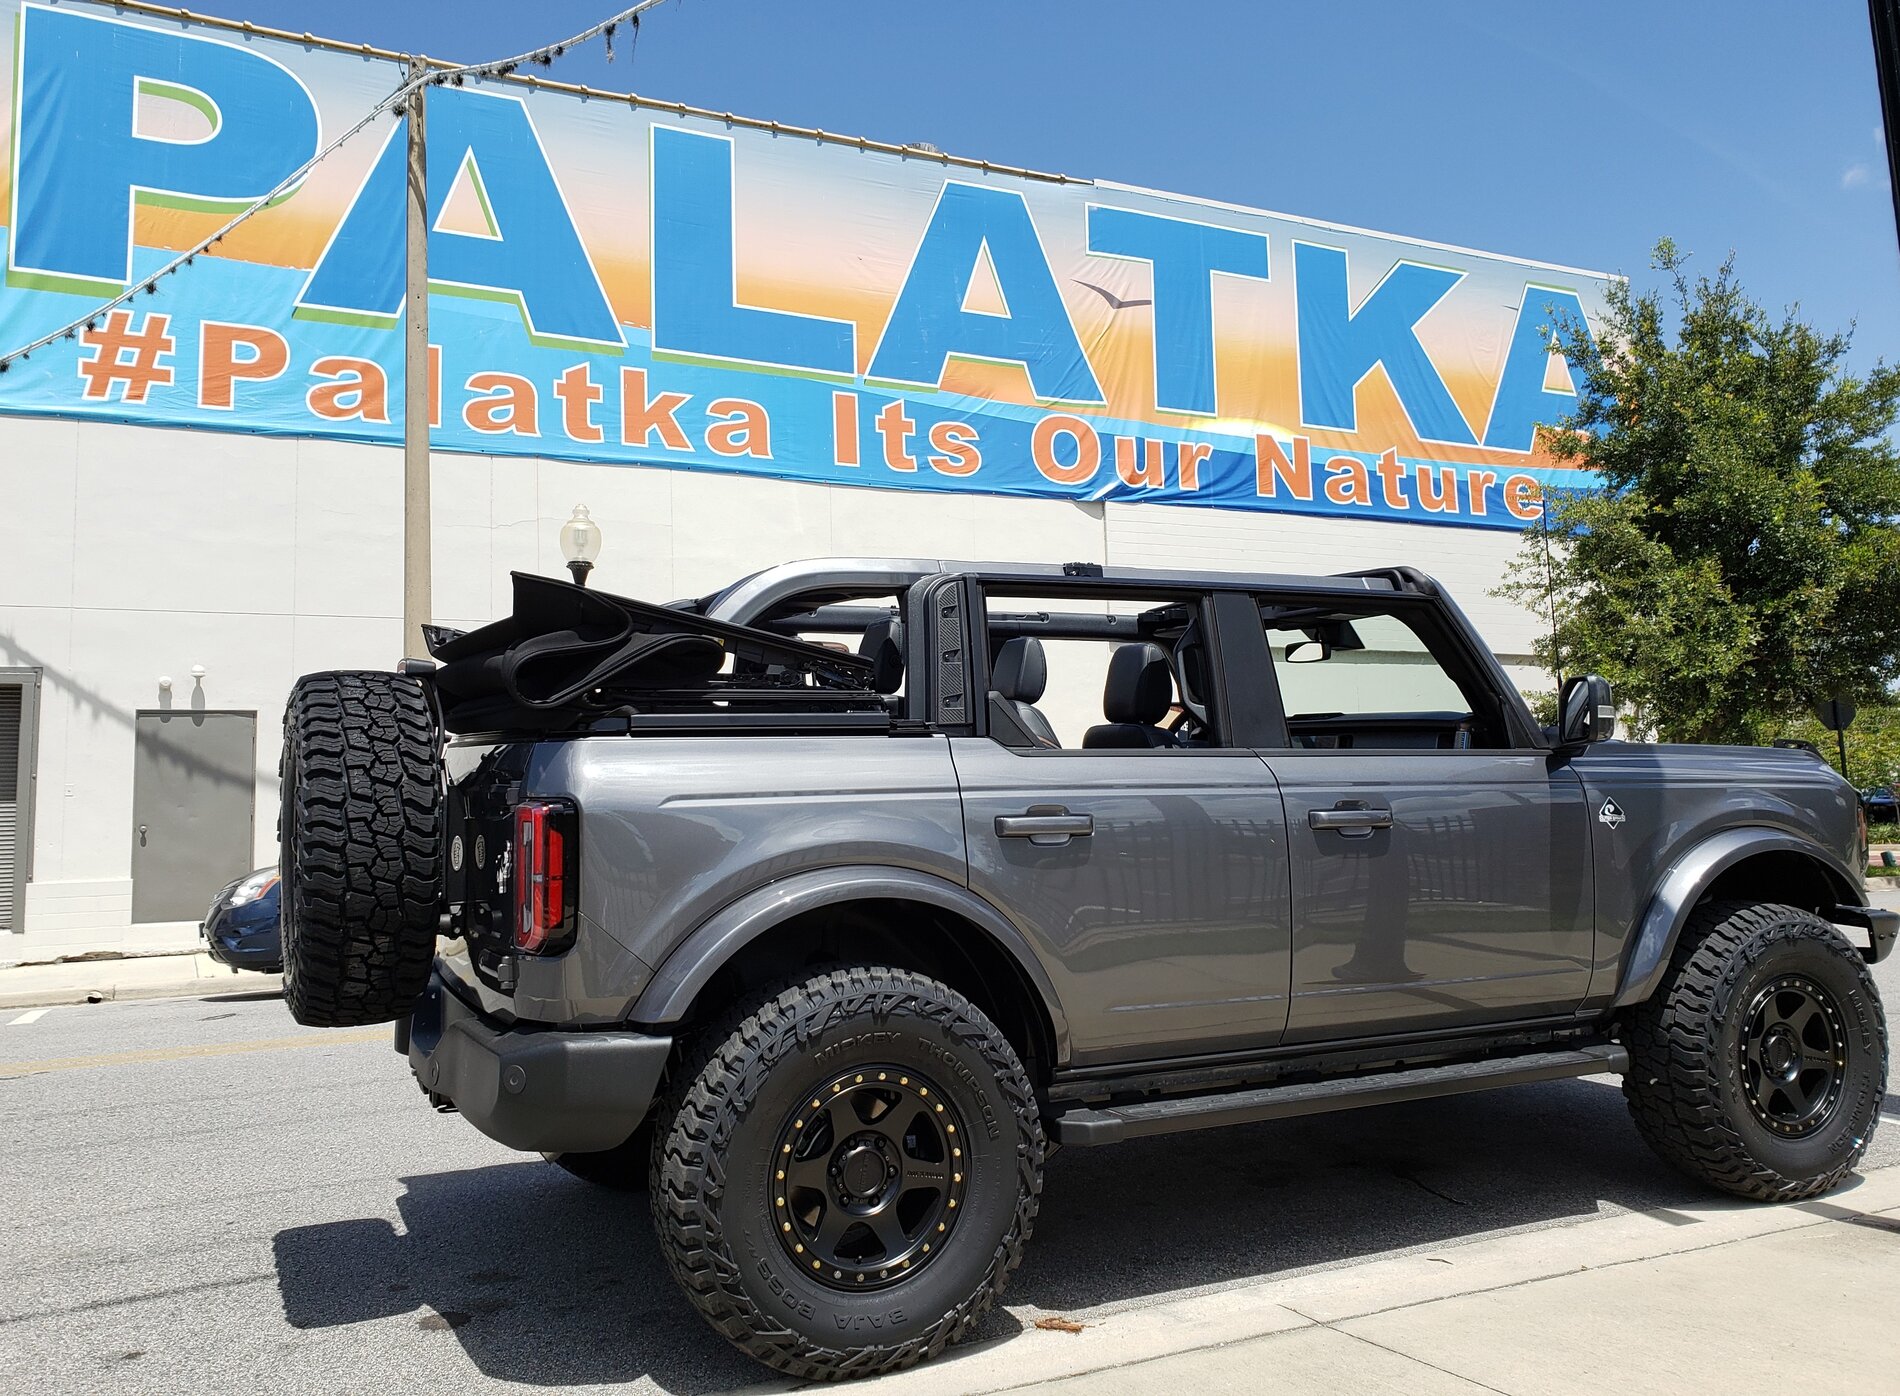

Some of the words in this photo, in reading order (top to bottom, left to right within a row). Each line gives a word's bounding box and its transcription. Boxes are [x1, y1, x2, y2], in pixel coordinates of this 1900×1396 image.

[7, 2, 1614, 455] PALATKA
[831, 390, 982, 478] Its
[1031, 415, 1212, 492] Our
[1255, 433, 1545, 520] Nature
[814, 1032, 901, 1066] MICKEY
[919, 1037, 1000, 1141] THOMPSON
[757, 1257, 817, 1321] BOSS
[833, 1306, 908, 1331] BAJA
